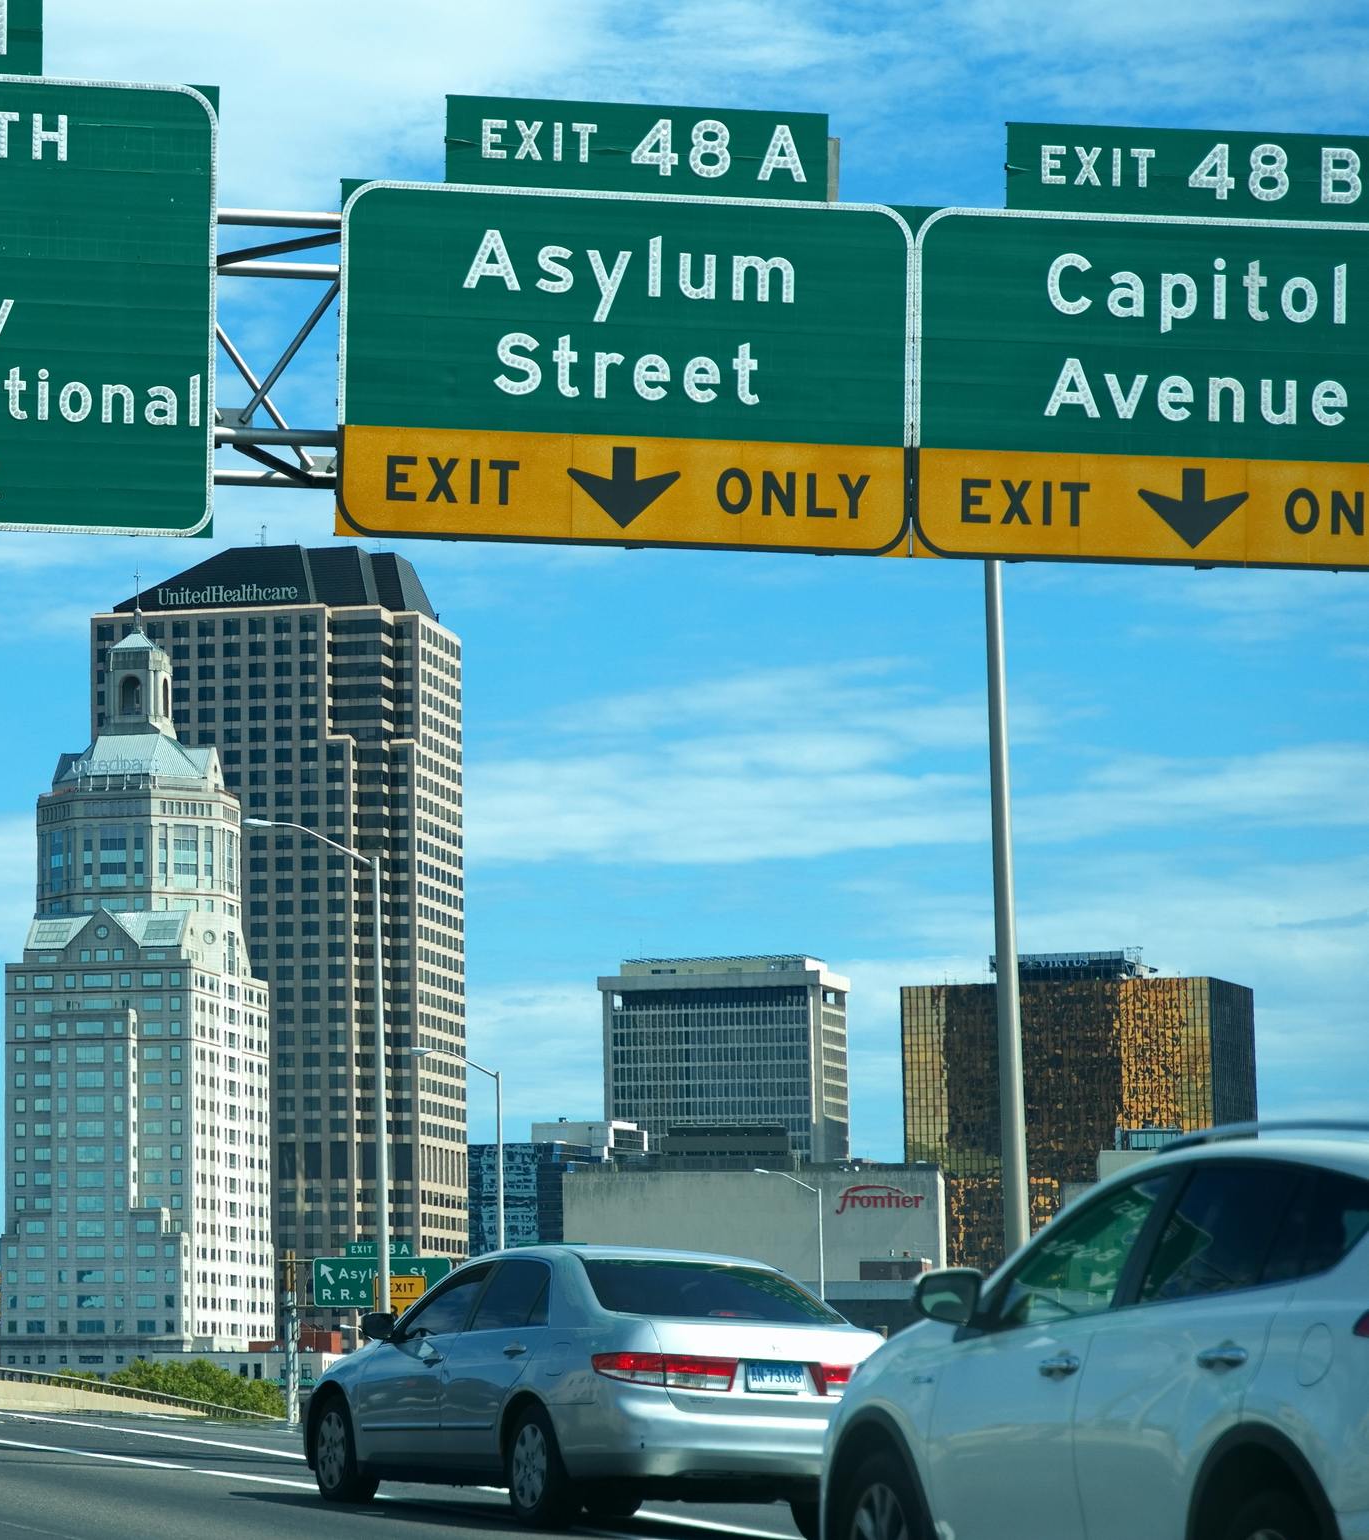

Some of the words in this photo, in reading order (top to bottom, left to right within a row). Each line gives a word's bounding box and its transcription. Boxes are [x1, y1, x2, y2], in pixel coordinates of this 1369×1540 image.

[482, 119, 597, 162] EXIT
[631, 119, 730, 177] 48
[758, 125, 806, 182] A
[1042, 145, 1155, 187] EXIT
[1189, 144, 1289, 201] 48
[1321, 148, 1361, 204] B
[463, 230, 794, 322] Asylum
[1047, 253, 1346, 333] Capitol
[494, 333, 759, 405] Street
[1044, 358, 1347, 426] Avenue
[386, 455, 519, 505] EXIT
[717, 468, 870, 519] ONLY
[961, 478, 1090, 527] EXIT
[158, 584, 298, 606] UnitedHealthcare
[835, 1185, 924, 1214] frontier
[339, 1267, 396, 1284] Asyl
[351, 1245, 373, 1254] EXIT
[400, 1244, 410, 1254] A
[323, 1288, 335, 1300] R.
[341, 1288, 354, 1300] R.
[359, 1290, 367, 1299] &
